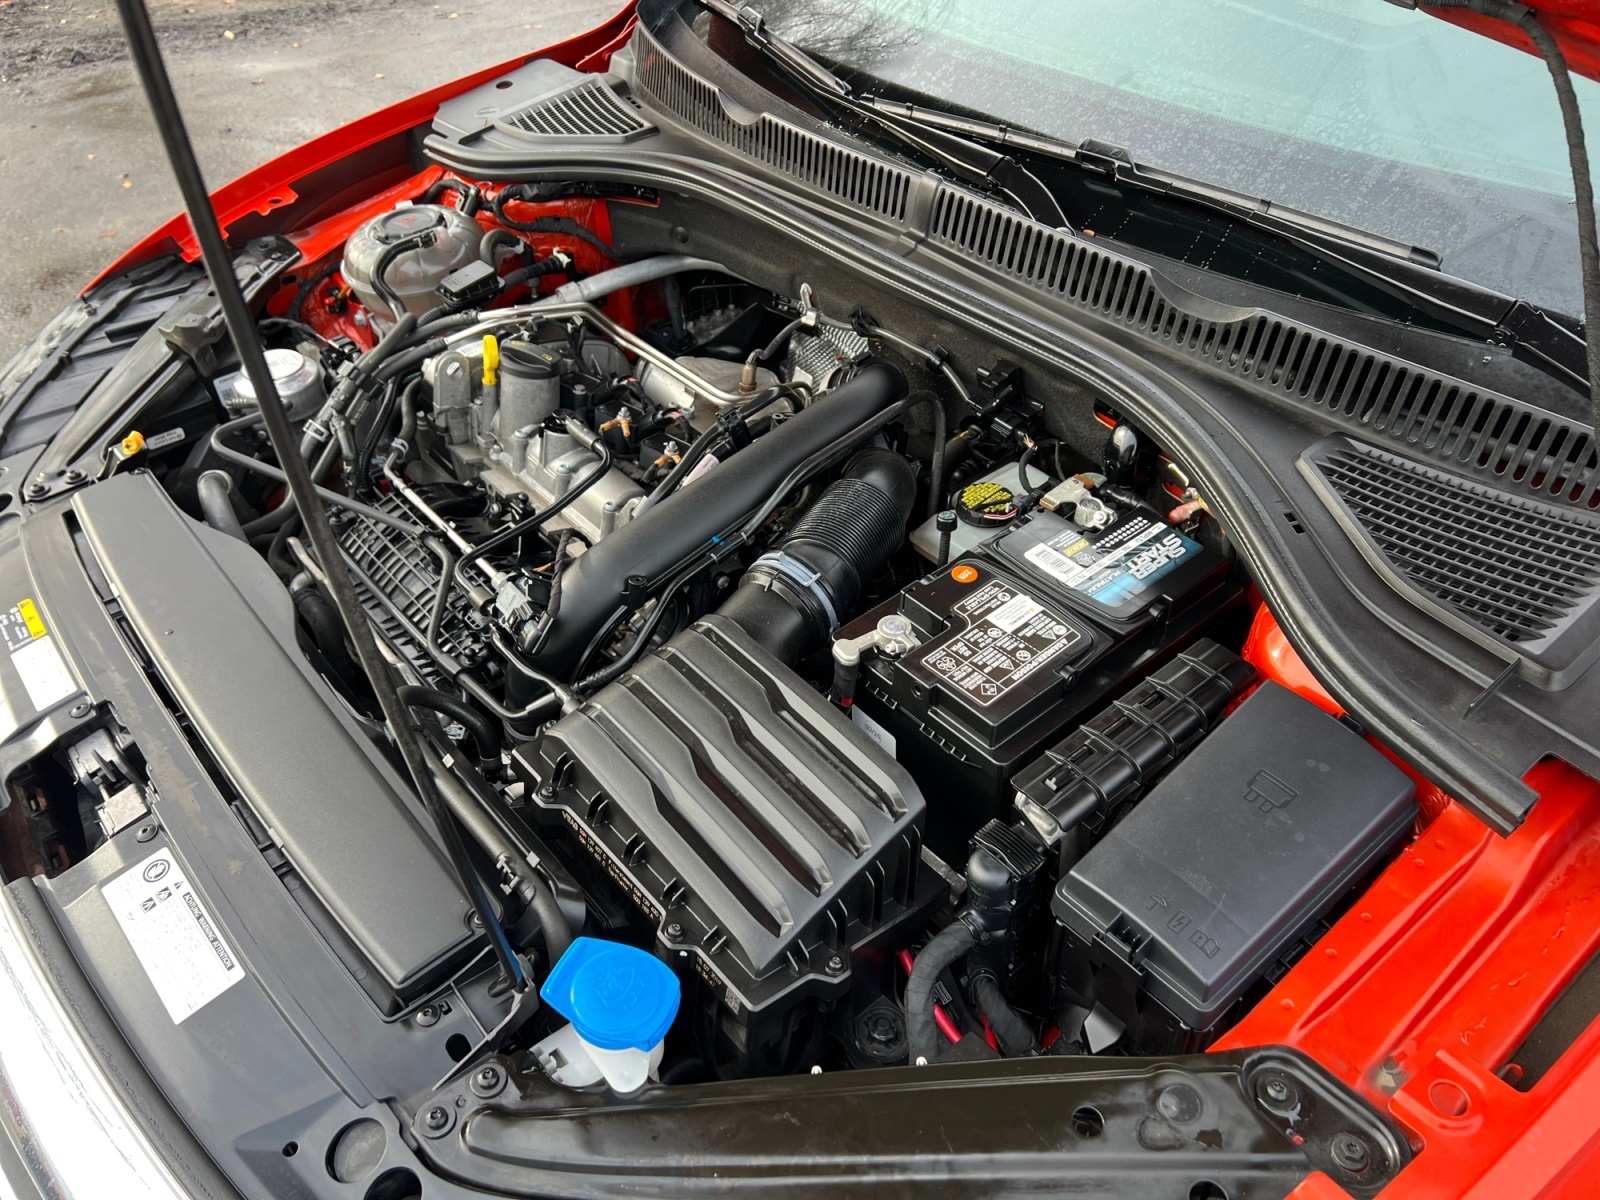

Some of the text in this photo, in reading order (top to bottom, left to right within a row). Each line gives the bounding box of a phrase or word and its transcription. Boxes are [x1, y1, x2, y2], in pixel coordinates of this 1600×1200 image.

[1122, 532, 1183, 574] START
[1130, 544, 1187, 580] SUPER
[1085, 570, 1121, 593] PLATINUM
[1010, 641, 1063, 680] DANGER/POISON
[183, 893, 232, 967] ACHTUNG WARNING ATTENTION
